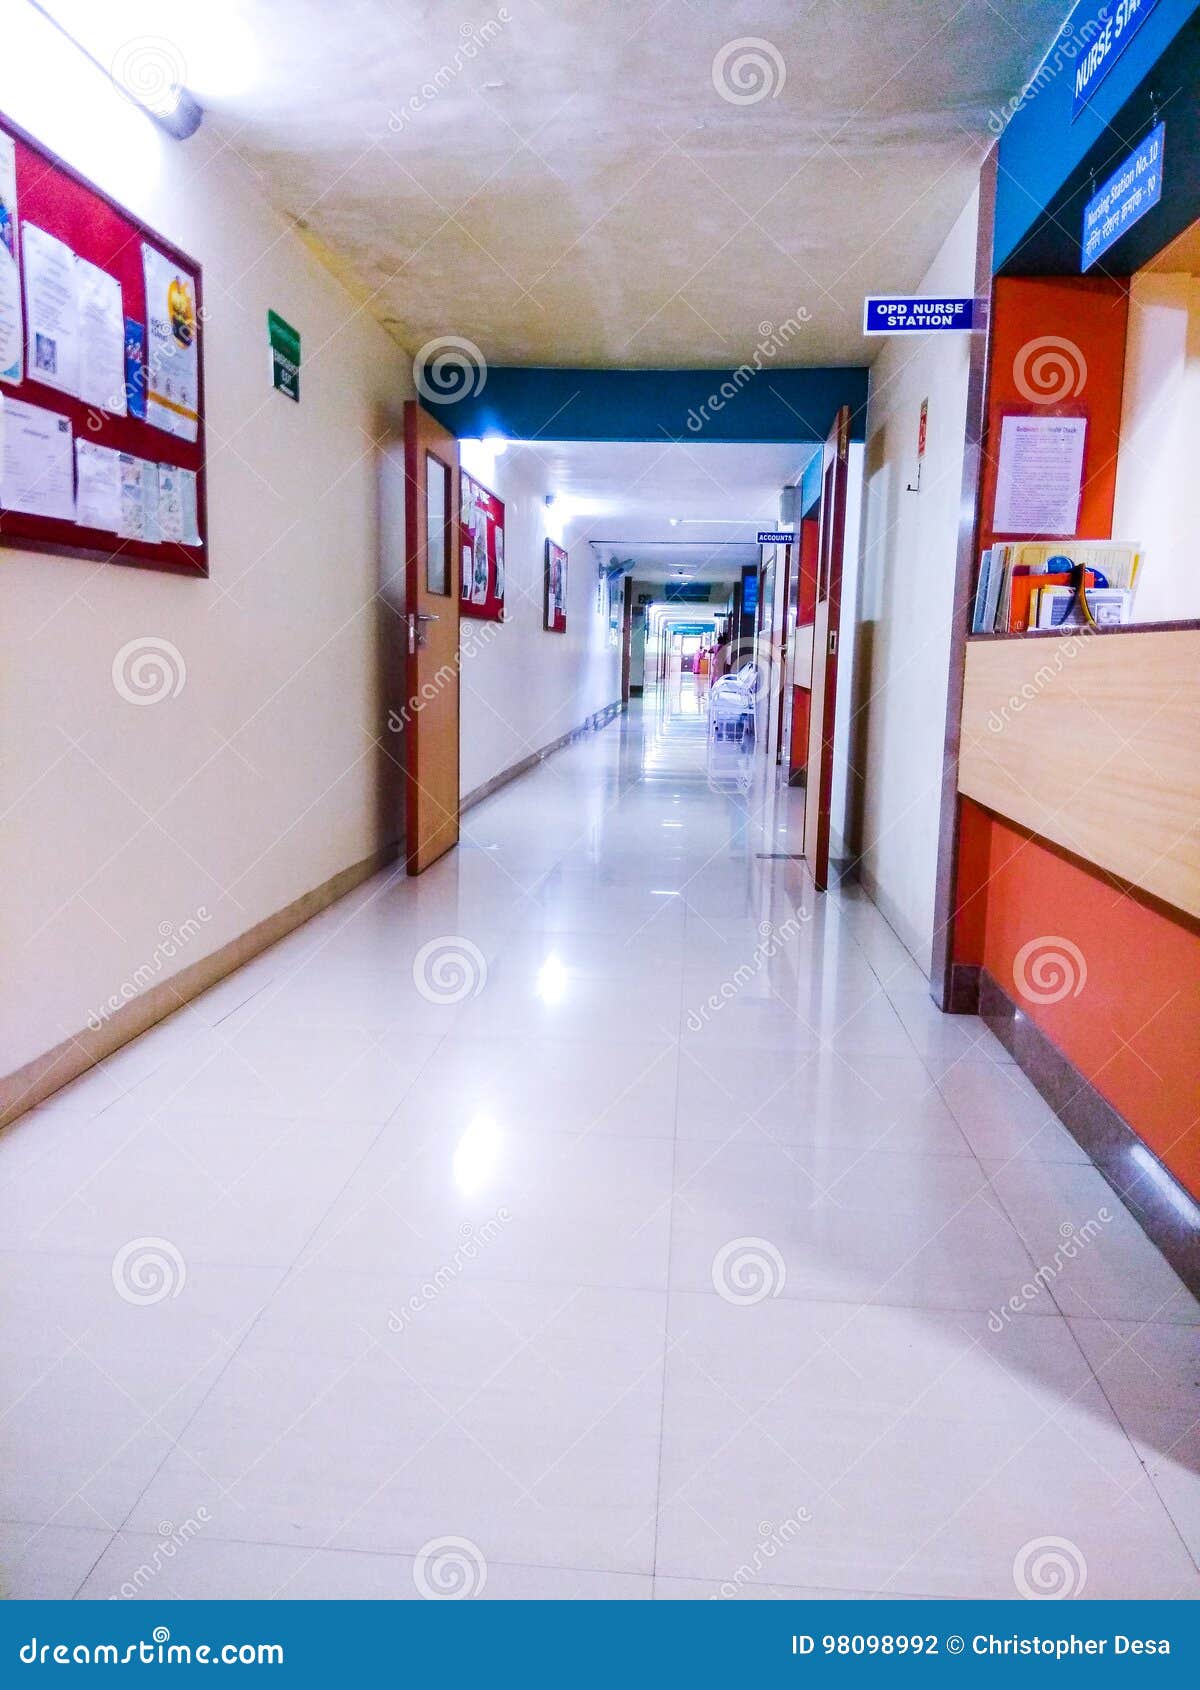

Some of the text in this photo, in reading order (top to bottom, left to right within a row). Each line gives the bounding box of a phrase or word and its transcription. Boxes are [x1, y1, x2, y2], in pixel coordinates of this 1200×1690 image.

[1075, 0, 1141, 98] NURSE STA
[1088, 193, 1110, 230] Nursing
[1110, 168, 1135, 205] Station
[877, 303, 964, 315] OPD NURSE
[887, 315, 953, 326] STATION
